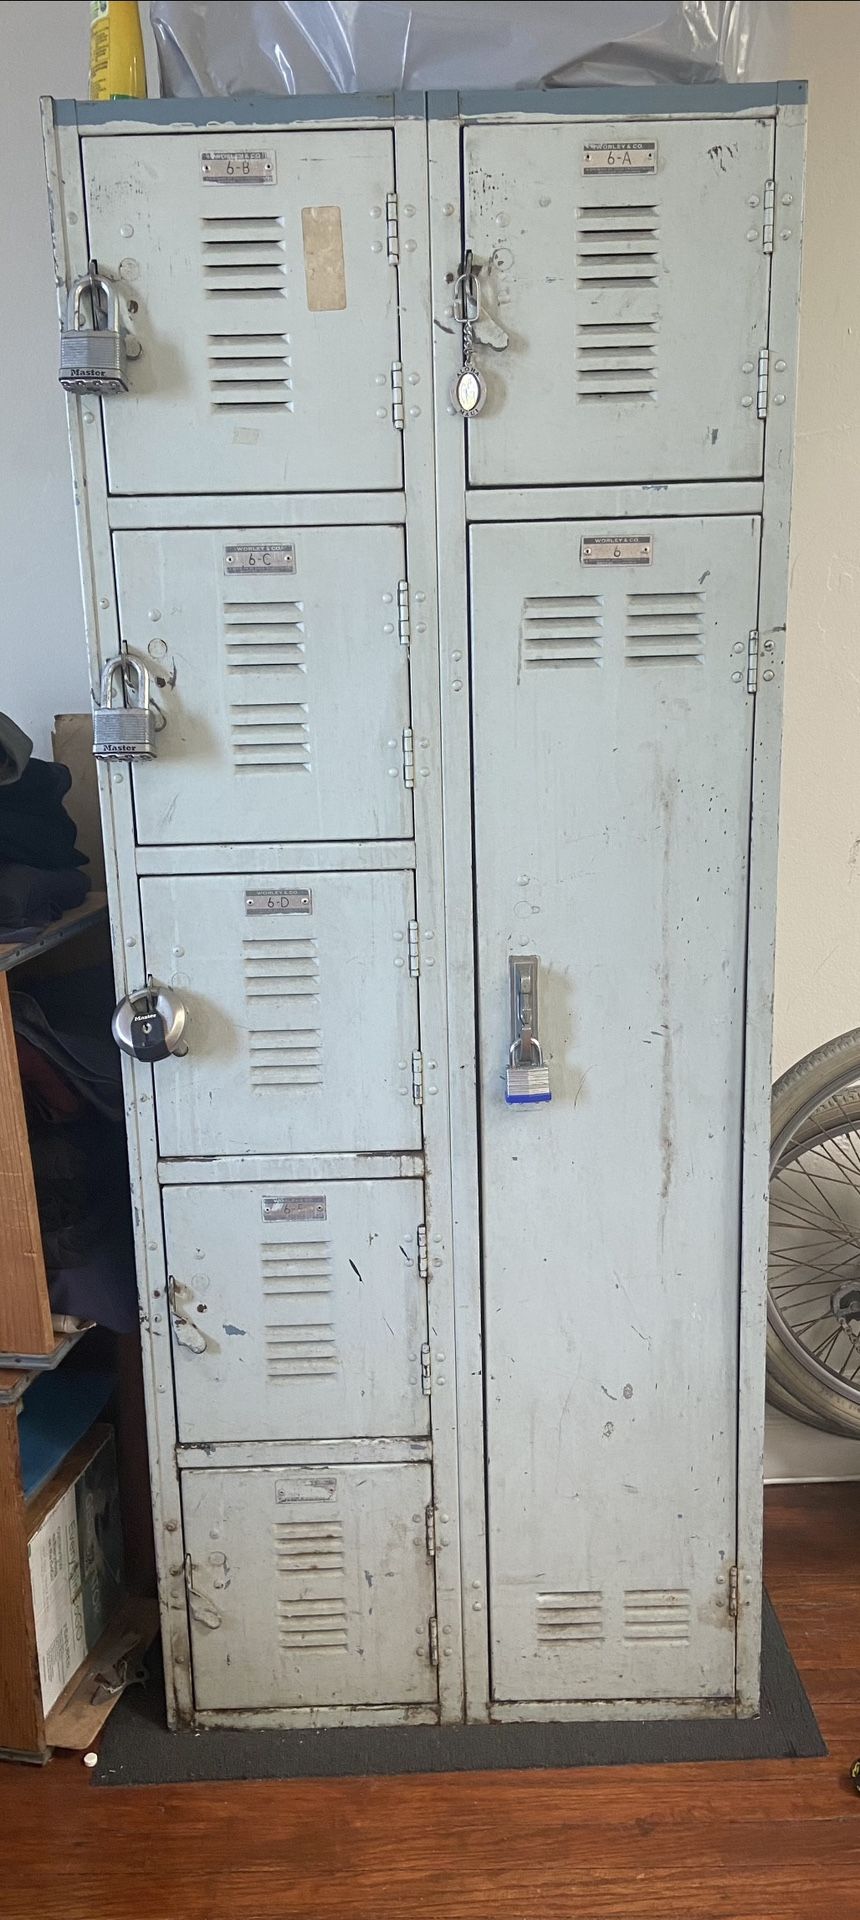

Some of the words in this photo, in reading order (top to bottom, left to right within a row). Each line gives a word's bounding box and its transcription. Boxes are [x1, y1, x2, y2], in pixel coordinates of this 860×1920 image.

[607, 151, 632, 165] 6-A
[226, 161, 250, 175] 6-B
[70, 369, 106, 377] Master
[457, 366, 480, 378] ALOHA
[460, 408, 479, 417] MAUI
[613, 546, 621, 557] 6
[248, 553, 272, 566] 6-C
[267, 896, 290, 908] 6-D
[134, 1013, 157, 1021] Master
